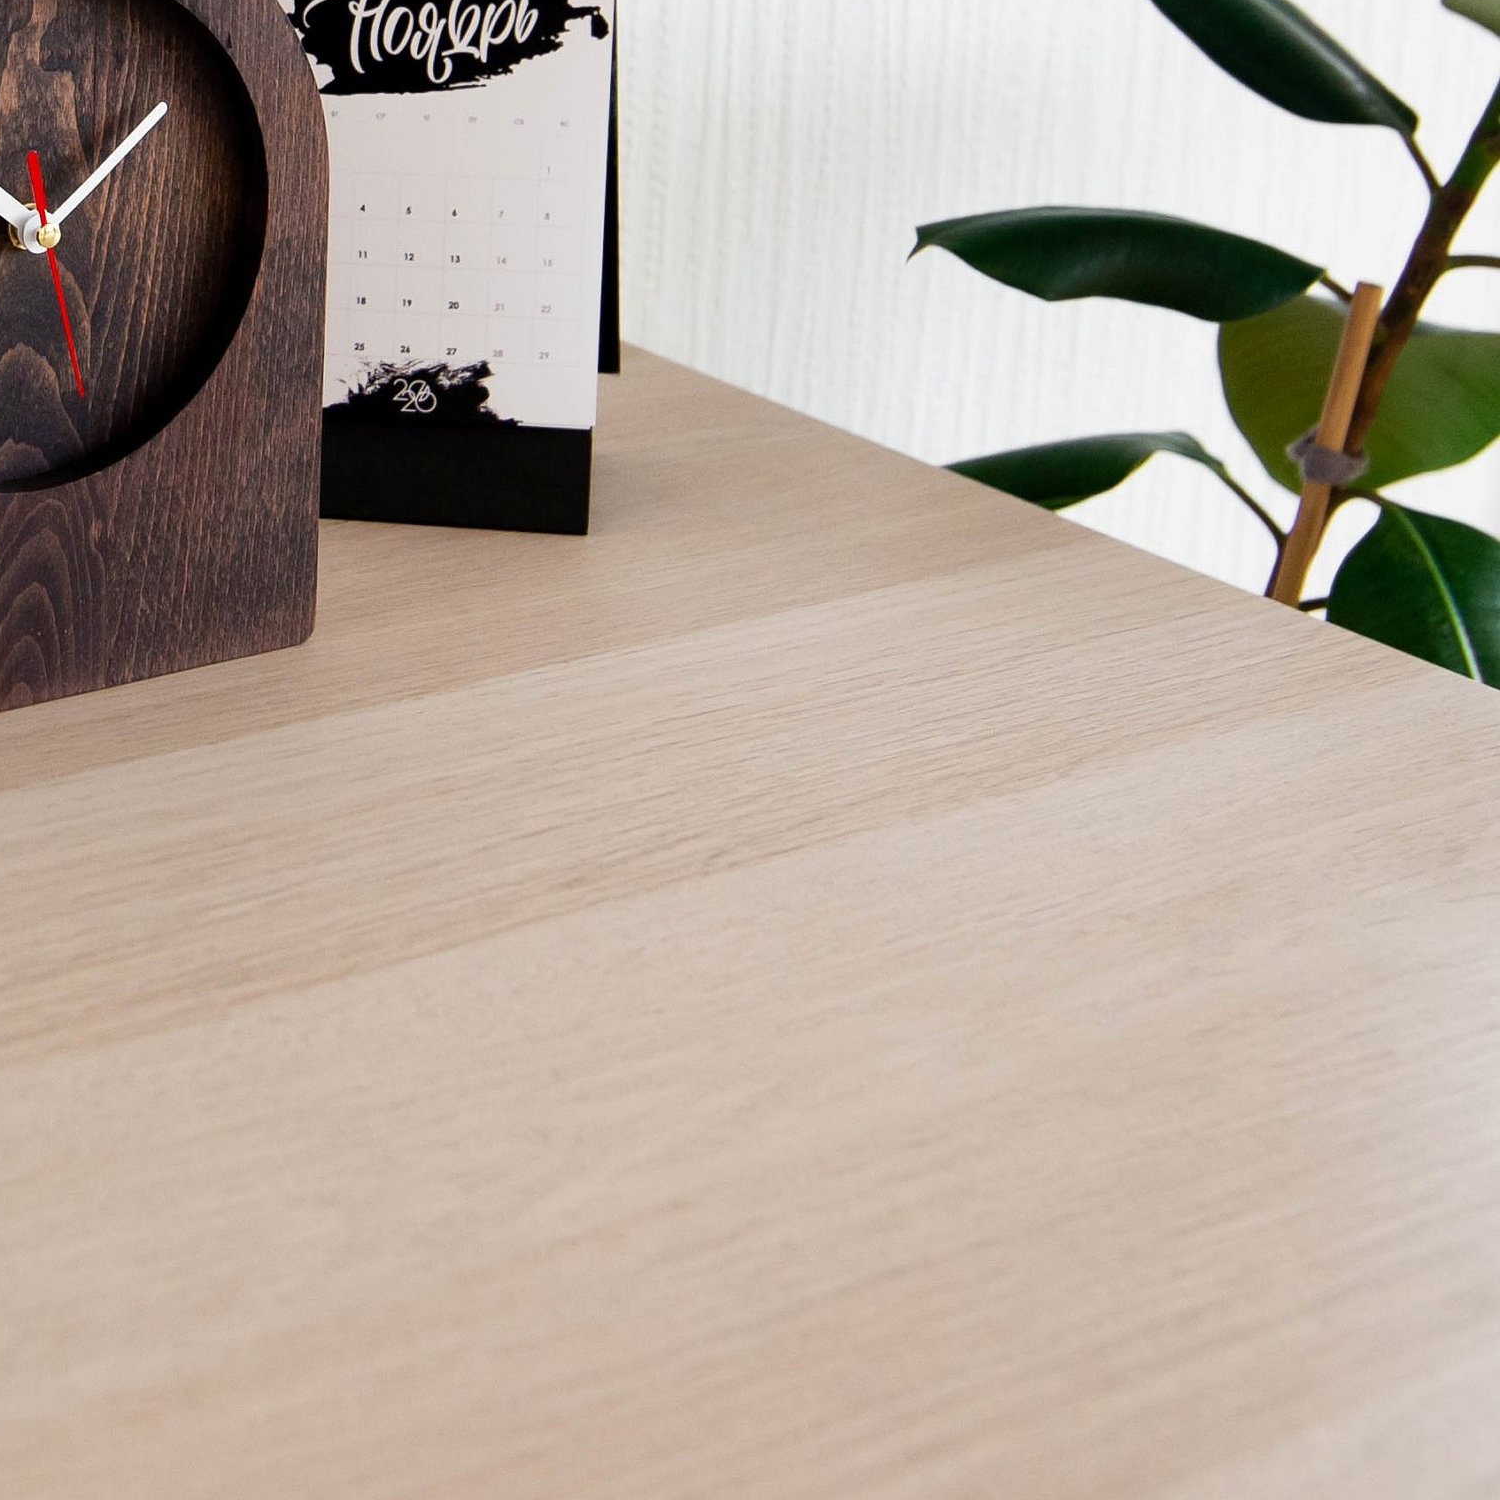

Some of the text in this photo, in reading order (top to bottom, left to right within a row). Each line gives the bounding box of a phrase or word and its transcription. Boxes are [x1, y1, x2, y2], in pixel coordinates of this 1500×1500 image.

[358, 250, 368, 259] 11
[404, 252, 415, 262] 12
[450, 254, 461, 264] 13
[356, 296, 367, 306] 18
[402, 298, 413, 307] 19
[448, 301, 460, 310] 20
[354, 342, 365, 351] 25
[400, 345, 411, 354] 26
[446, 347, 458, 356] 27
